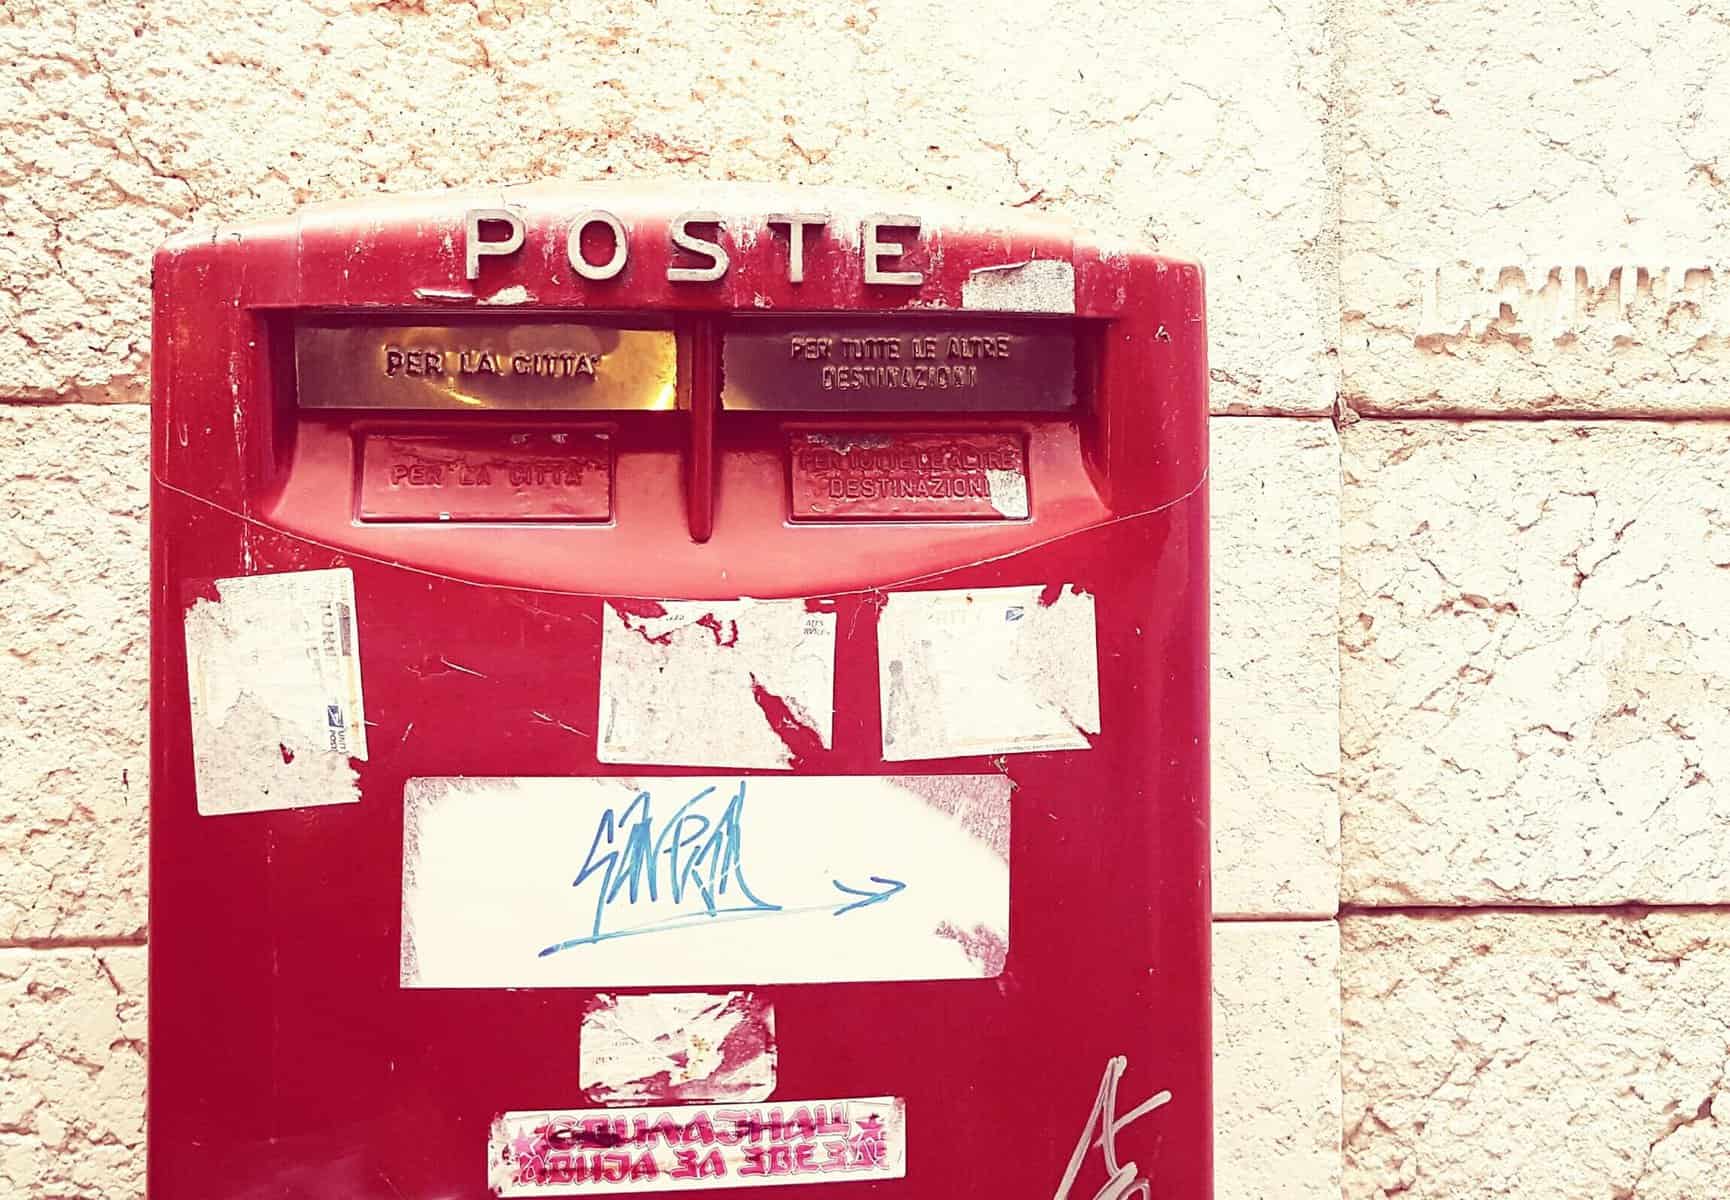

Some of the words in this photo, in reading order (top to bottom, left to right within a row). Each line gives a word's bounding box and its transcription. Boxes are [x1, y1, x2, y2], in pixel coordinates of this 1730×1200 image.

[465, 208, 924, 285] POSTE
[791, 336, 832, 359] PER
[843, 337, 902, 358] TUTTE
[911, 337, 937, 358] LE
[947, 336, 1011, 358] ALTRE
[384, 349, 442, 377] PER
[459, 349, 499, 376] LA
[822, 365, 978, 390] DESTINAZIONI
[391, 464, 443, 487] PER
[457, 464, 491, 486] LA
[828, 478, 992, 499] DESTINAZIONI
